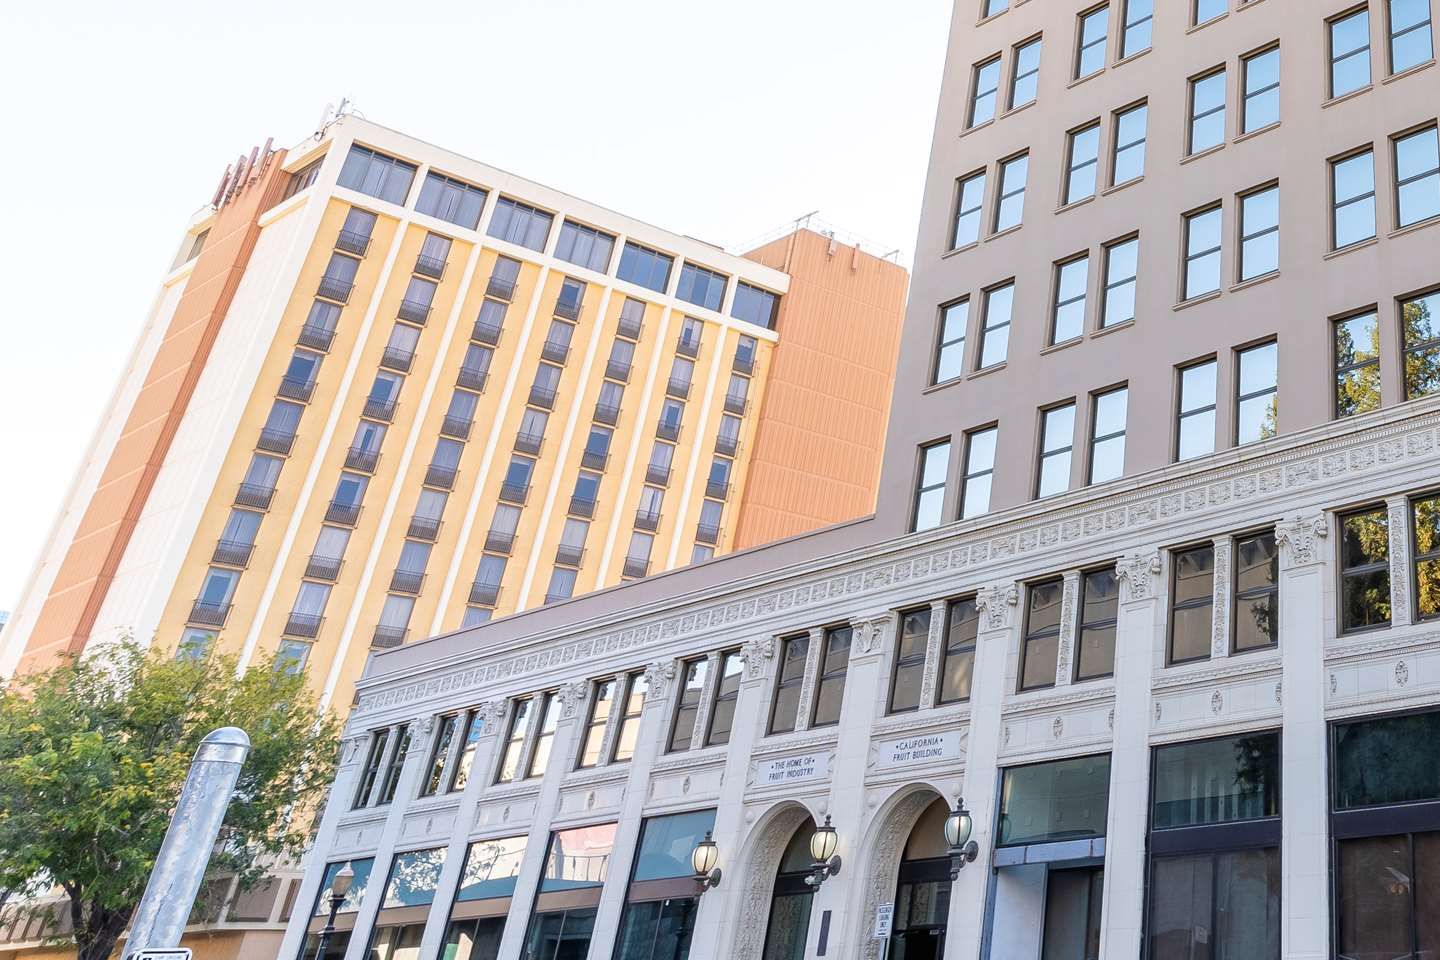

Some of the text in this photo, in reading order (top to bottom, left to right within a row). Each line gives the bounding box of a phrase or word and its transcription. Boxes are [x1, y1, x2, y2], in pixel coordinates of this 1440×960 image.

[899, 737, 939, 750] CALIFORNIA
[892, 747, 943, 761] FRUIT BUILDING
[775, 757, 812, 770] THE HOME OF
[768, 767, 814, 781] FRUIT INDUSTRY
